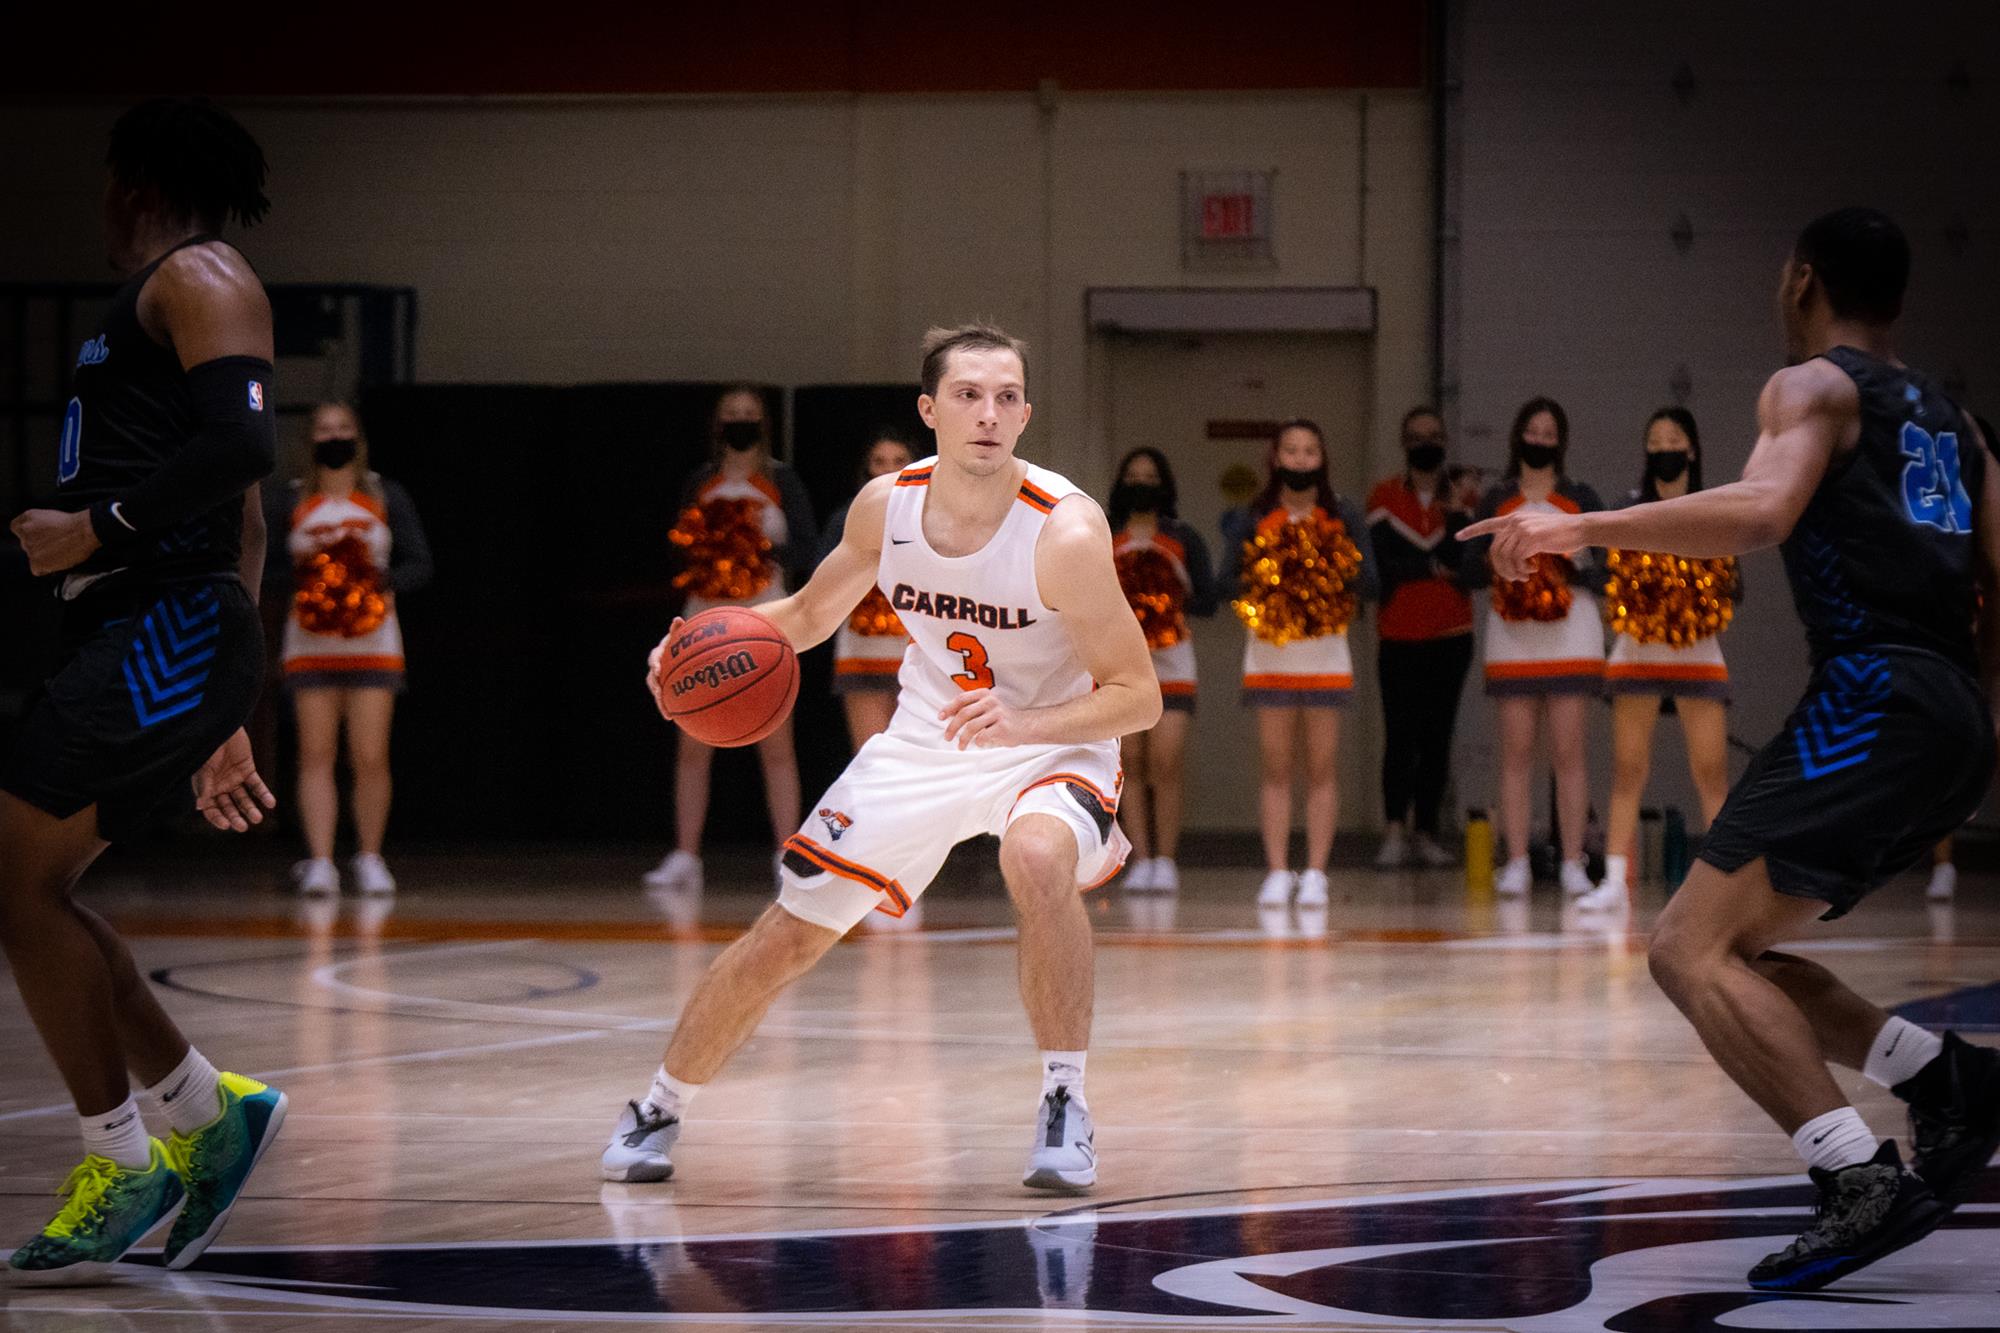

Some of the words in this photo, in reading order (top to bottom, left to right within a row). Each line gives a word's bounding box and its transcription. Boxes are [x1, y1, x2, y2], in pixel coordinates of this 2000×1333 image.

[892, 582, 1037, 630] CARROLL
[671, 650, 759, 697] Wilson
[946, 631, 996, 692] 3
